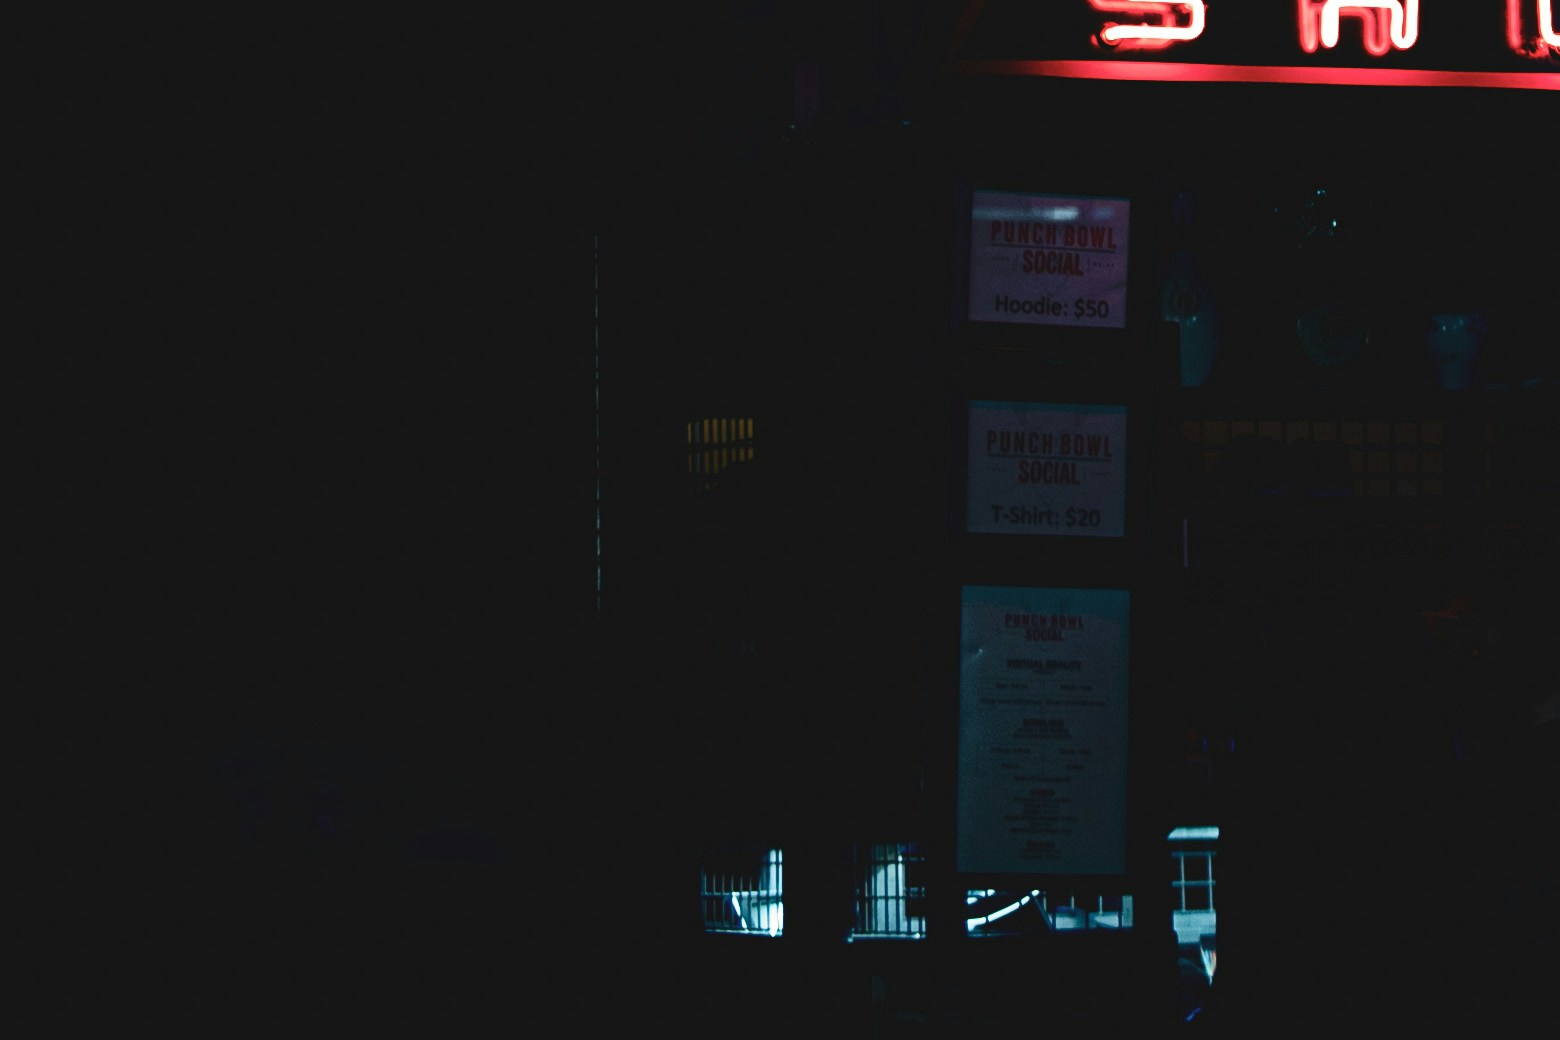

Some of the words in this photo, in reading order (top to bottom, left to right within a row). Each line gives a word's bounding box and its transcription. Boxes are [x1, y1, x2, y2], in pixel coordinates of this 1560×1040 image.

[990, 220, 1057, 246] PUNCH
[1063, 224, 1116, 250] BOWL
[1022, 250, 1083, 276] SOCIAL
[995, 295, 1068, 316] Hoodie:
[1074, 298, 1110, 319] $50
[987, 430, 1053, 454] PUNCH
[1060, 432, 1112, 458] BOWL
[1018, 460, 1080, 485] SOCIAL
[991, 505, 1059, 525] T-Shirt:
[1065, 507, 1100, 528] $20
[1005, 613, 1046, 627] PUNCH
[1051, 616, 1084, 629] BOWL
[1025, 629, 1064, 641] SOCIAL
